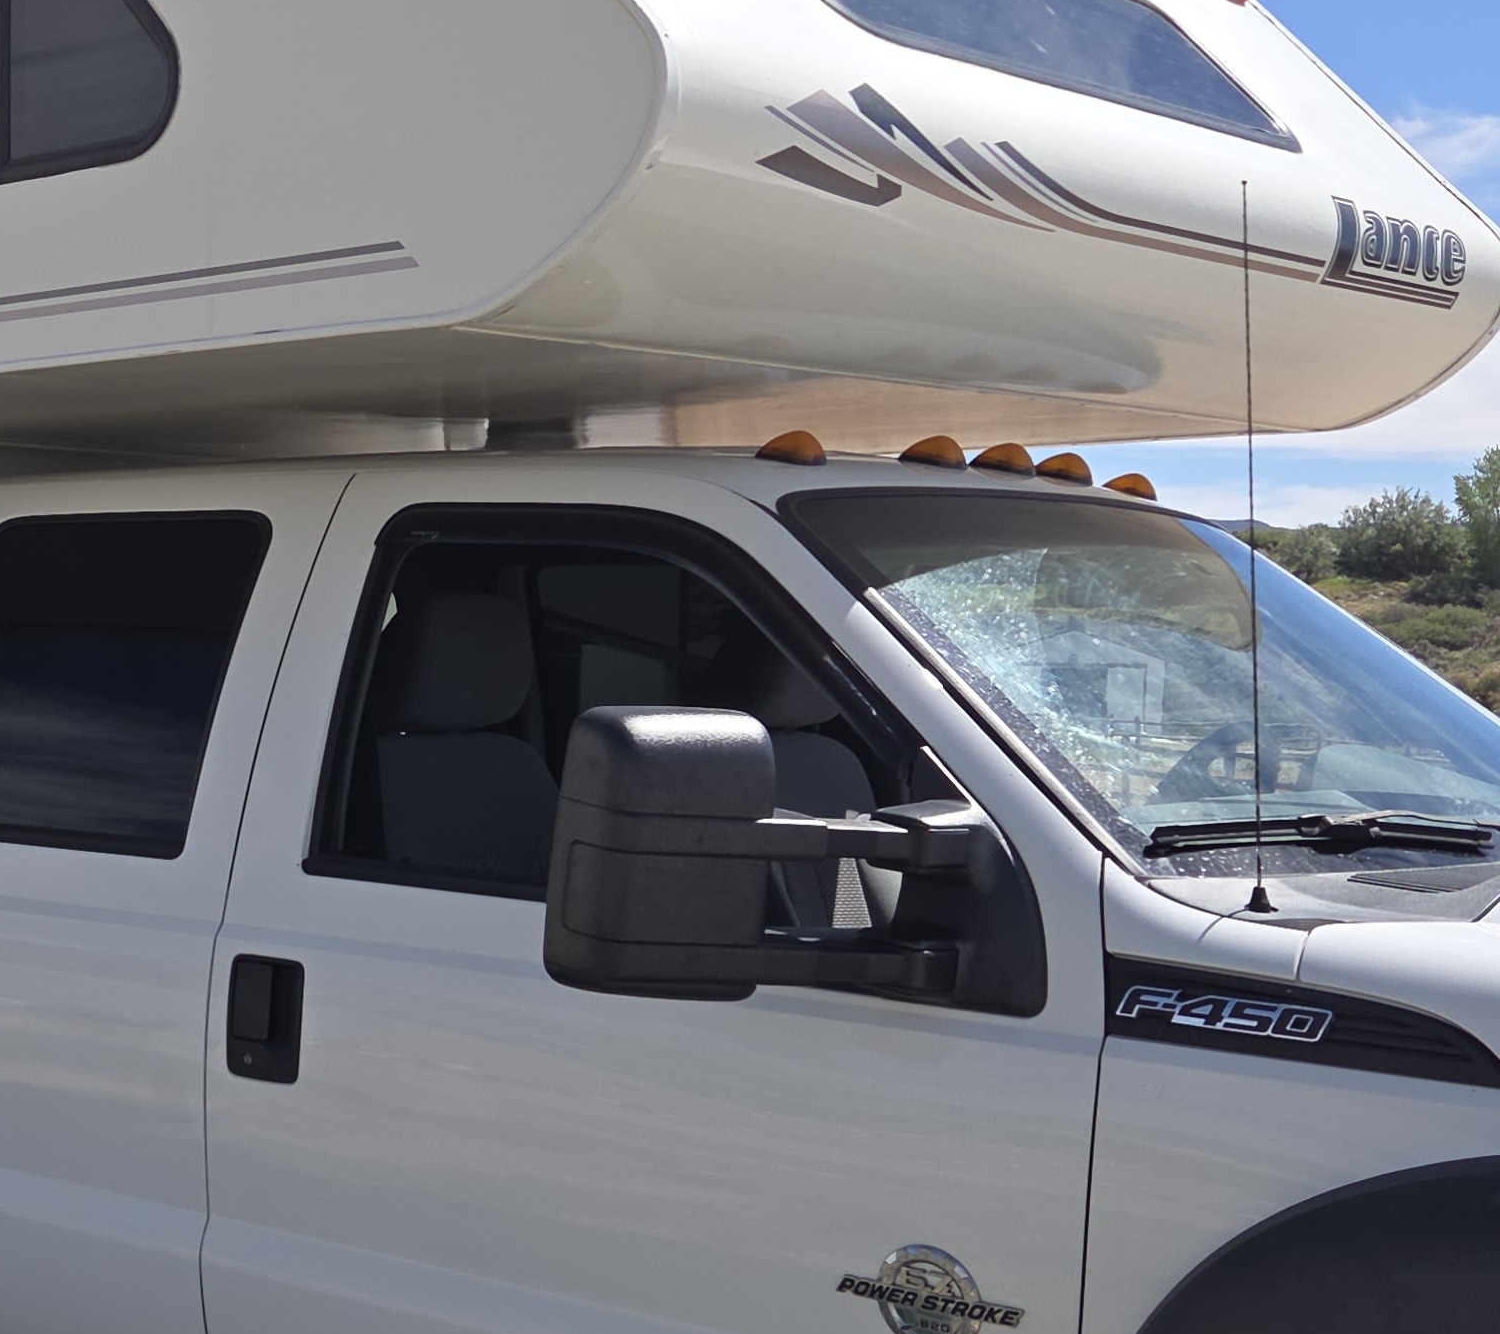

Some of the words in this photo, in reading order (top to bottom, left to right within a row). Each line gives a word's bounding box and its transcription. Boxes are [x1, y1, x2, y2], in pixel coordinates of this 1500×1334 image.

[1320, 195, 1467, 310] Lance
[1116, 985, 1334, 1043] F-450
[837, 1277, 919, 1307] POWER
[921, 1294, 1020, 1327] STROKE
